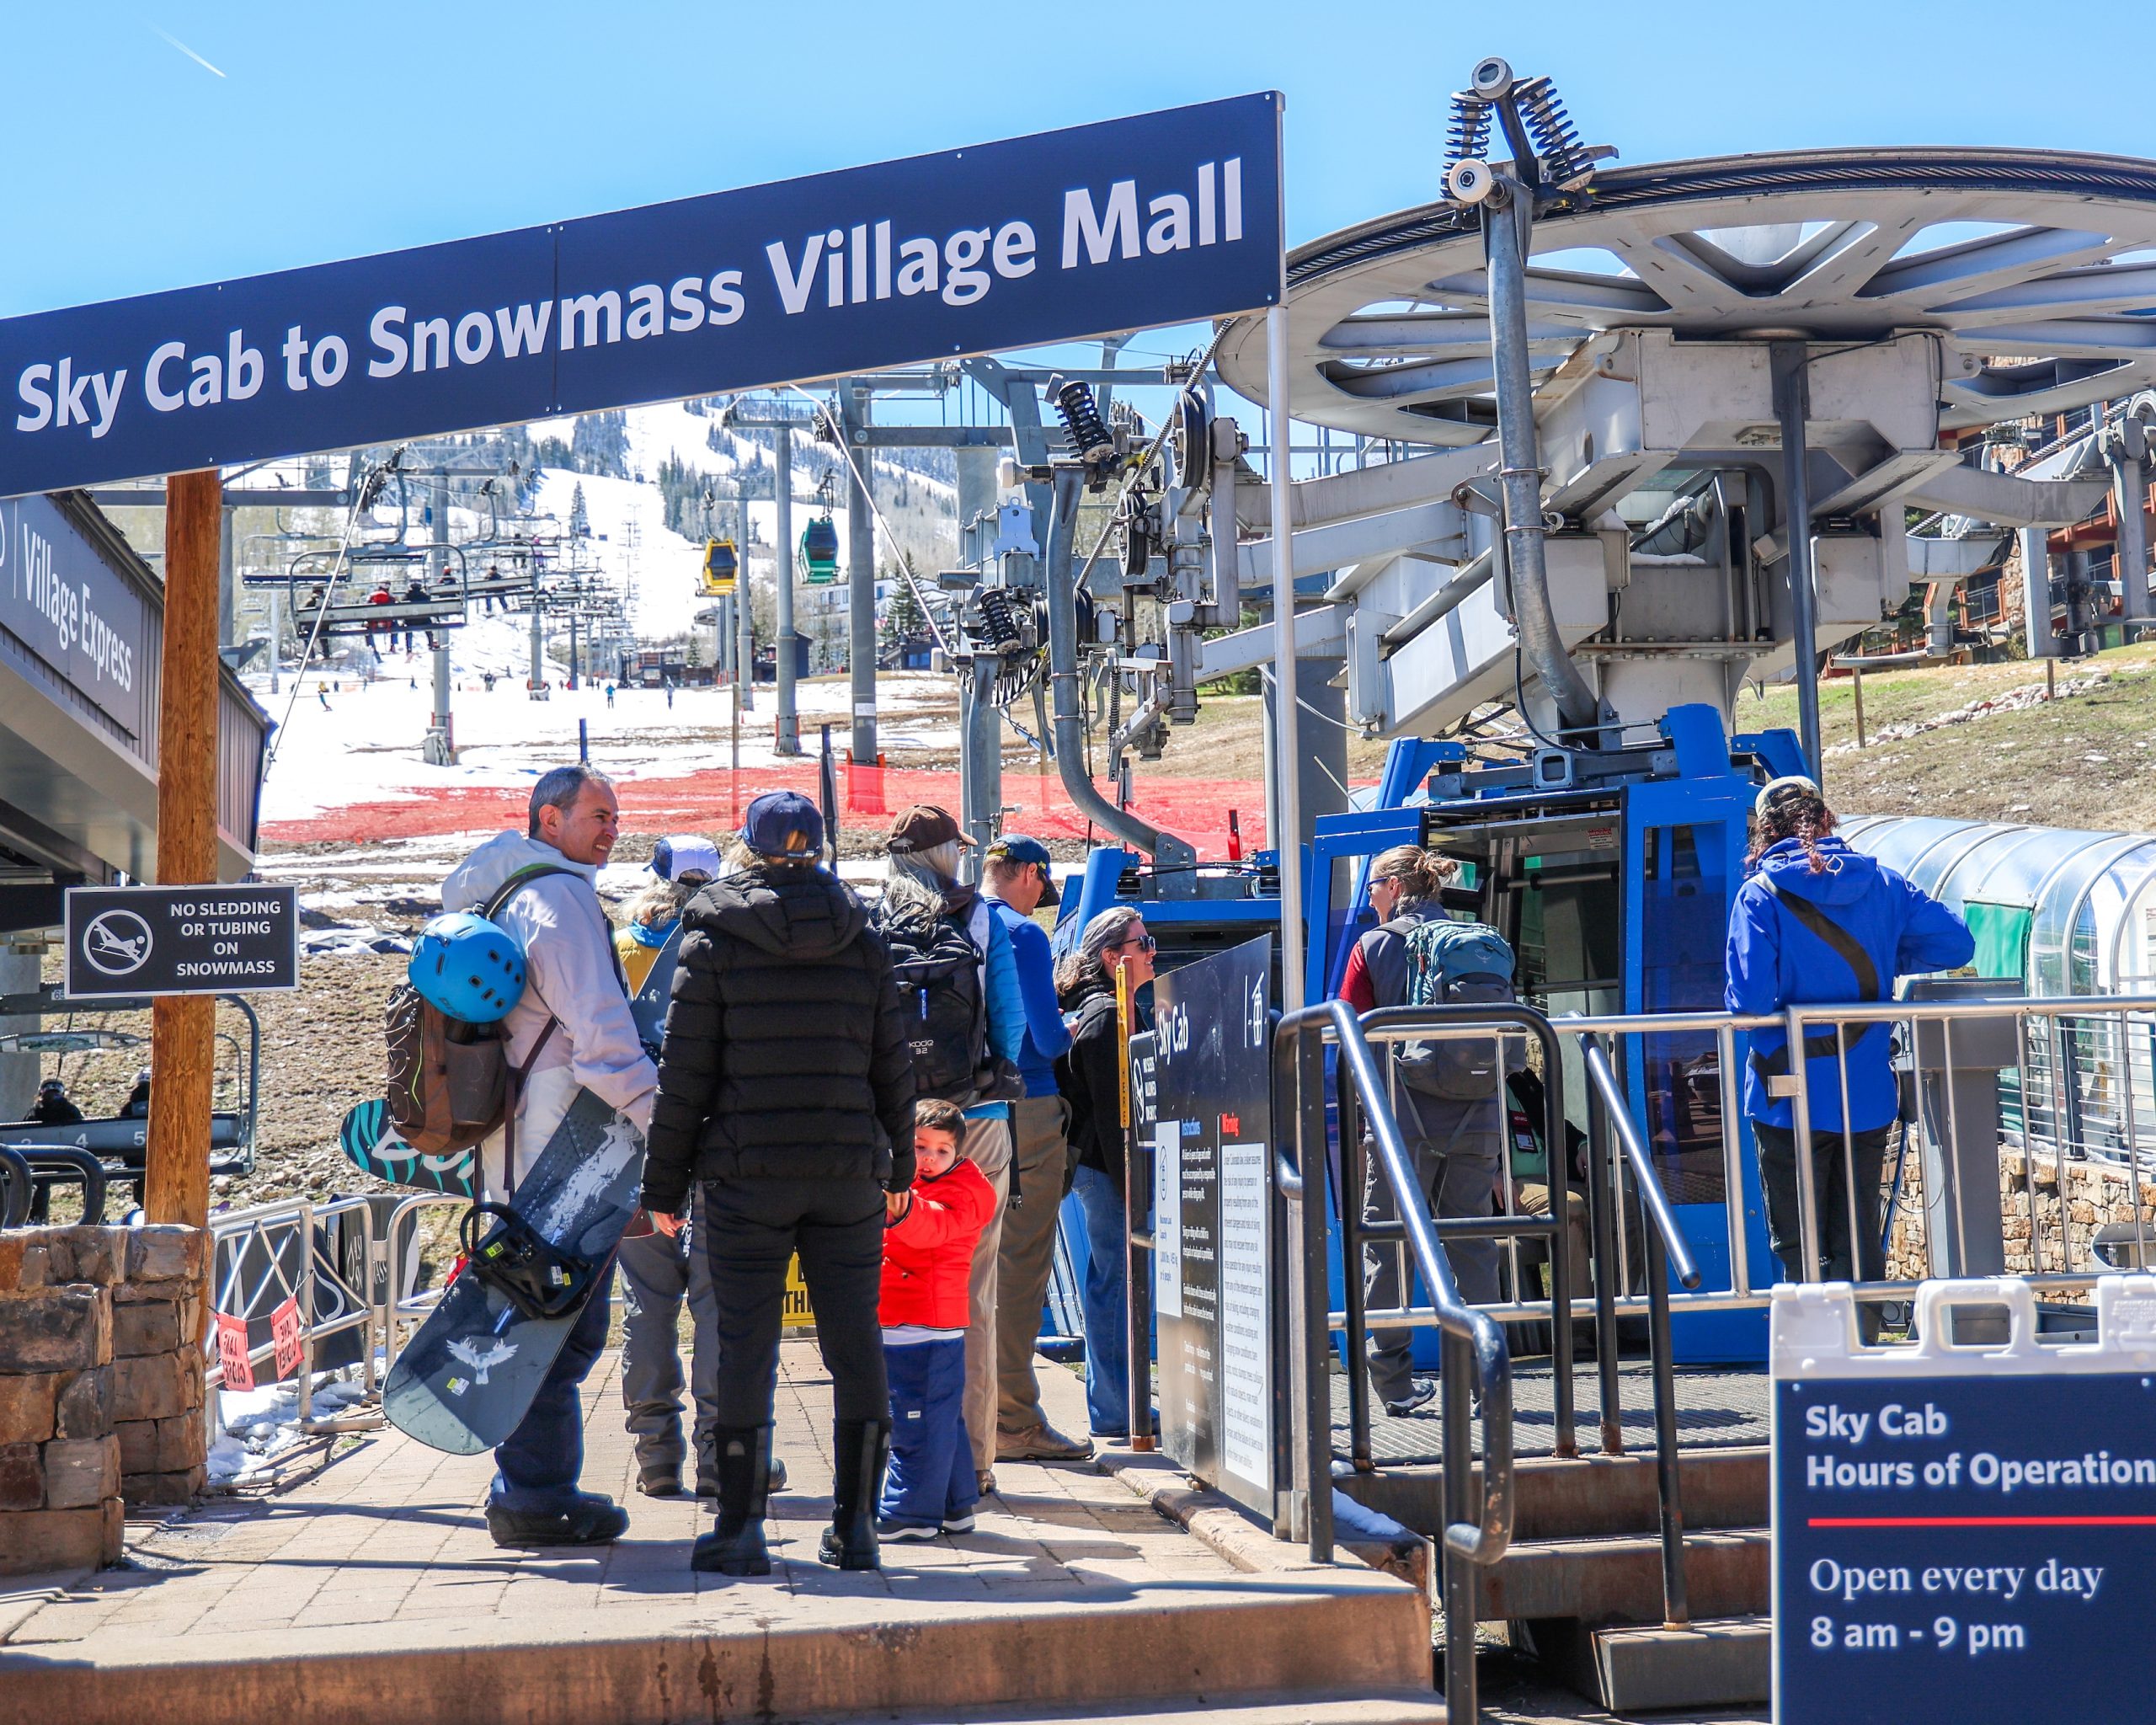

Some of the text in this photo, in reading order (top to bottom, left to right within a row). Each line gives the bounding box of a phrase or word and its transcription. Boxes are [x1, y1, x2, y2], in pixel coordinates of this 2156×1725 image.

[16, 157, 1242, 439] Sky Cab to Snowmass Village Mall
[23, 522, 132, 692] Village Express
[171, 900, 281, 917] NO SLEDDING
[180, 921, 271, 937] OR TUBING
[213, 942, 238, 955] ON
[177, 960, 275, 976] SNOWMASS
[1159, 1001, 1189, 1065] Sky Cab
[75, 1131, 147, 1148] 4 5
[1806, 1402, 1947, 1444] Sky Cab
[1806, 1450, 2156, 1493] Hours of Operation
[1809, 1558, 2104, 1601] Open every day
[1811, 1616, 2025, 1655] 8 am - 9 pm
